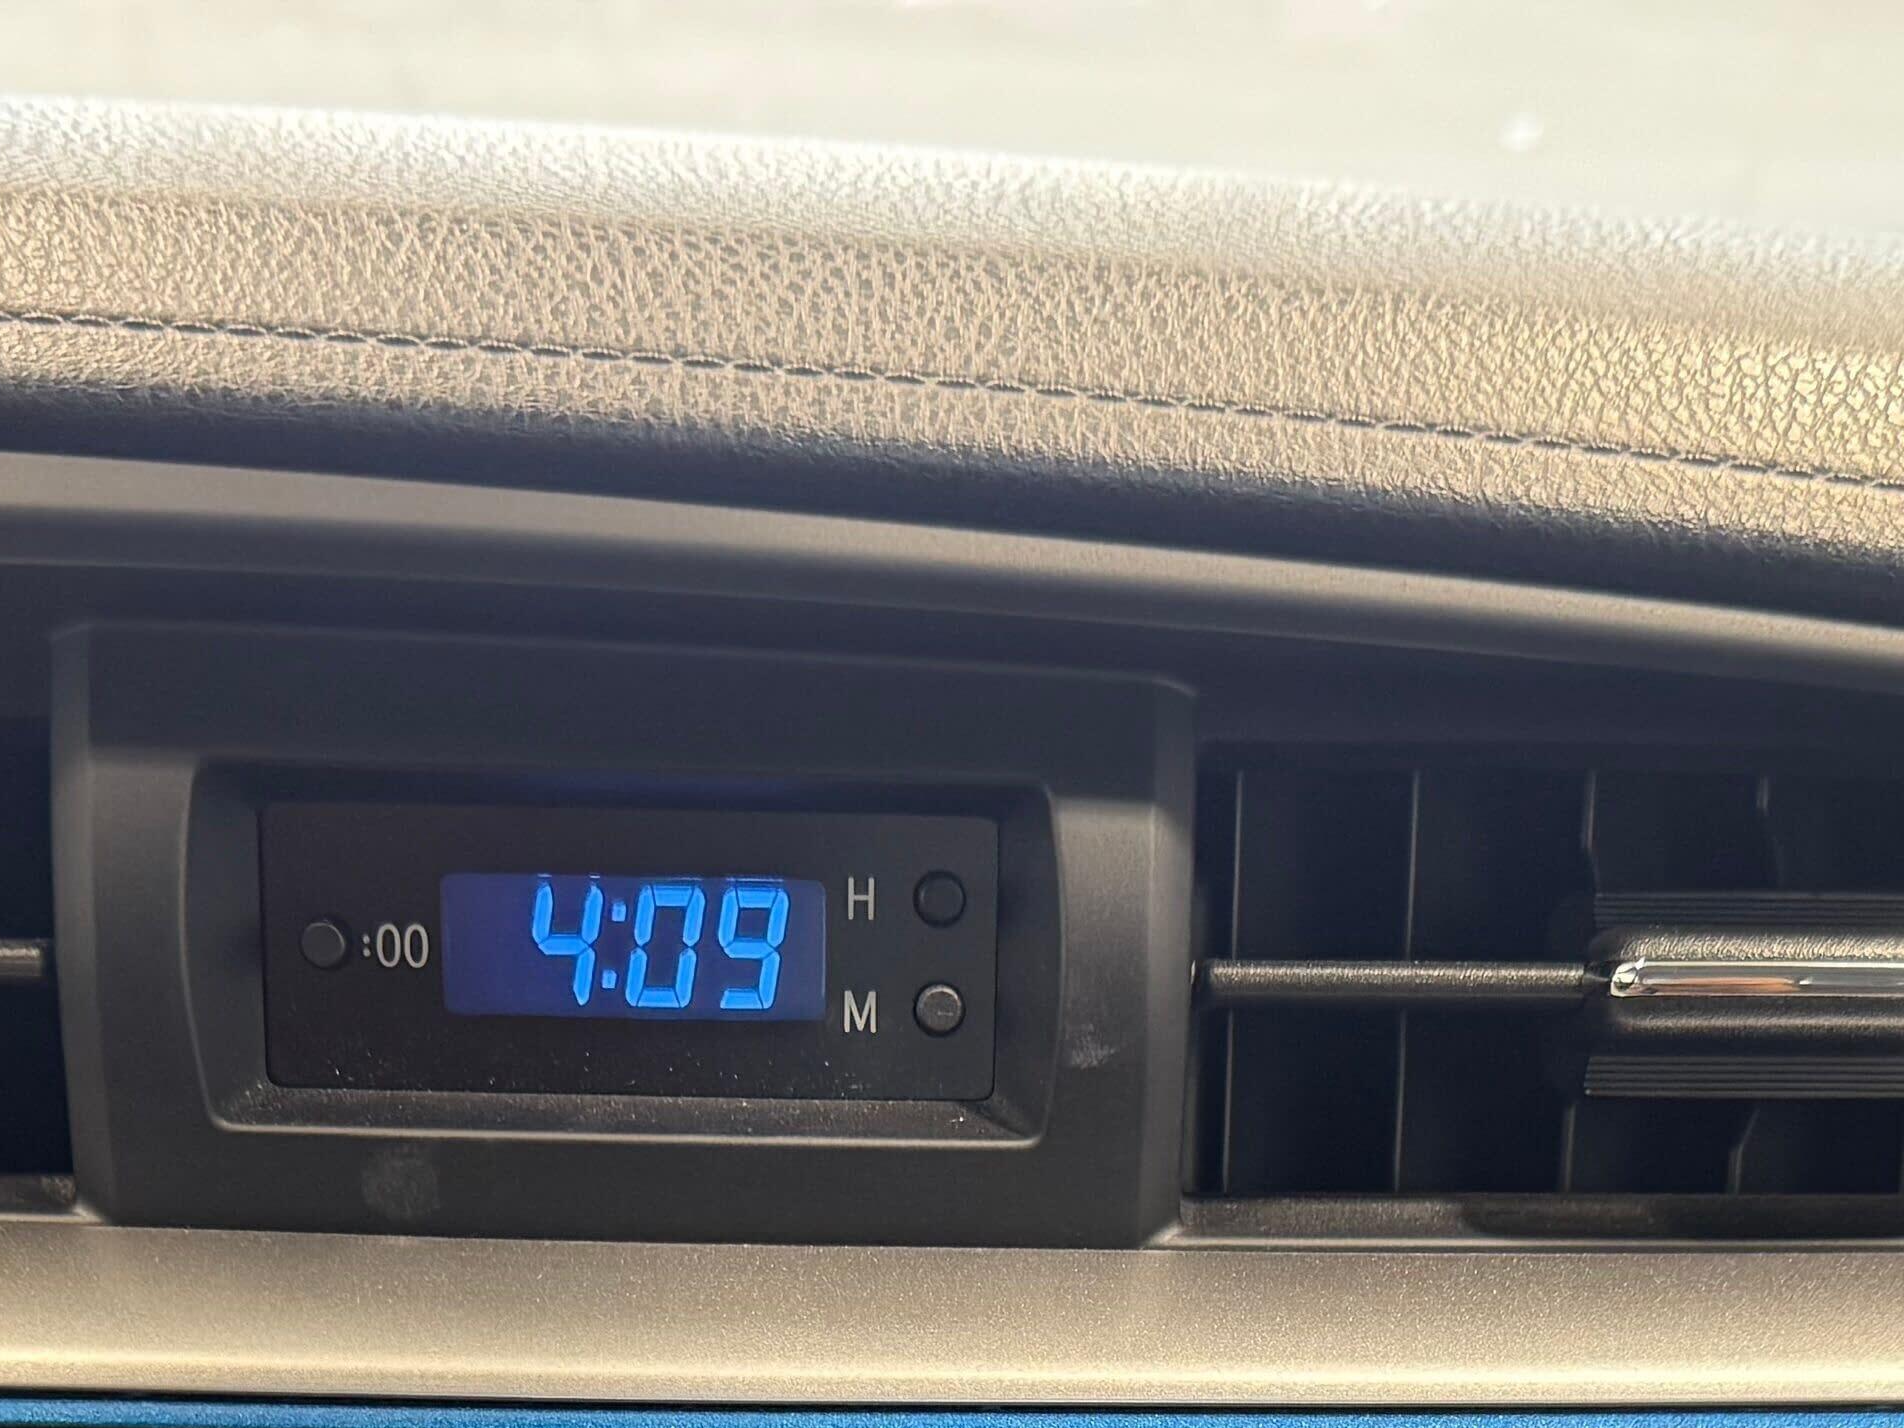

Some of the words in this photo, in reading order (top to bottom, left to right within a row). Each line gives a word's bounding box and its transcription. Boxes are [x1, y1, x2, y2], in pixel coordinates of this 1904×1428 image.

[846, 876, 876, 921] H
[530, 880, 792, 1011] 4:09
[841, 991, 878, 1034] M
